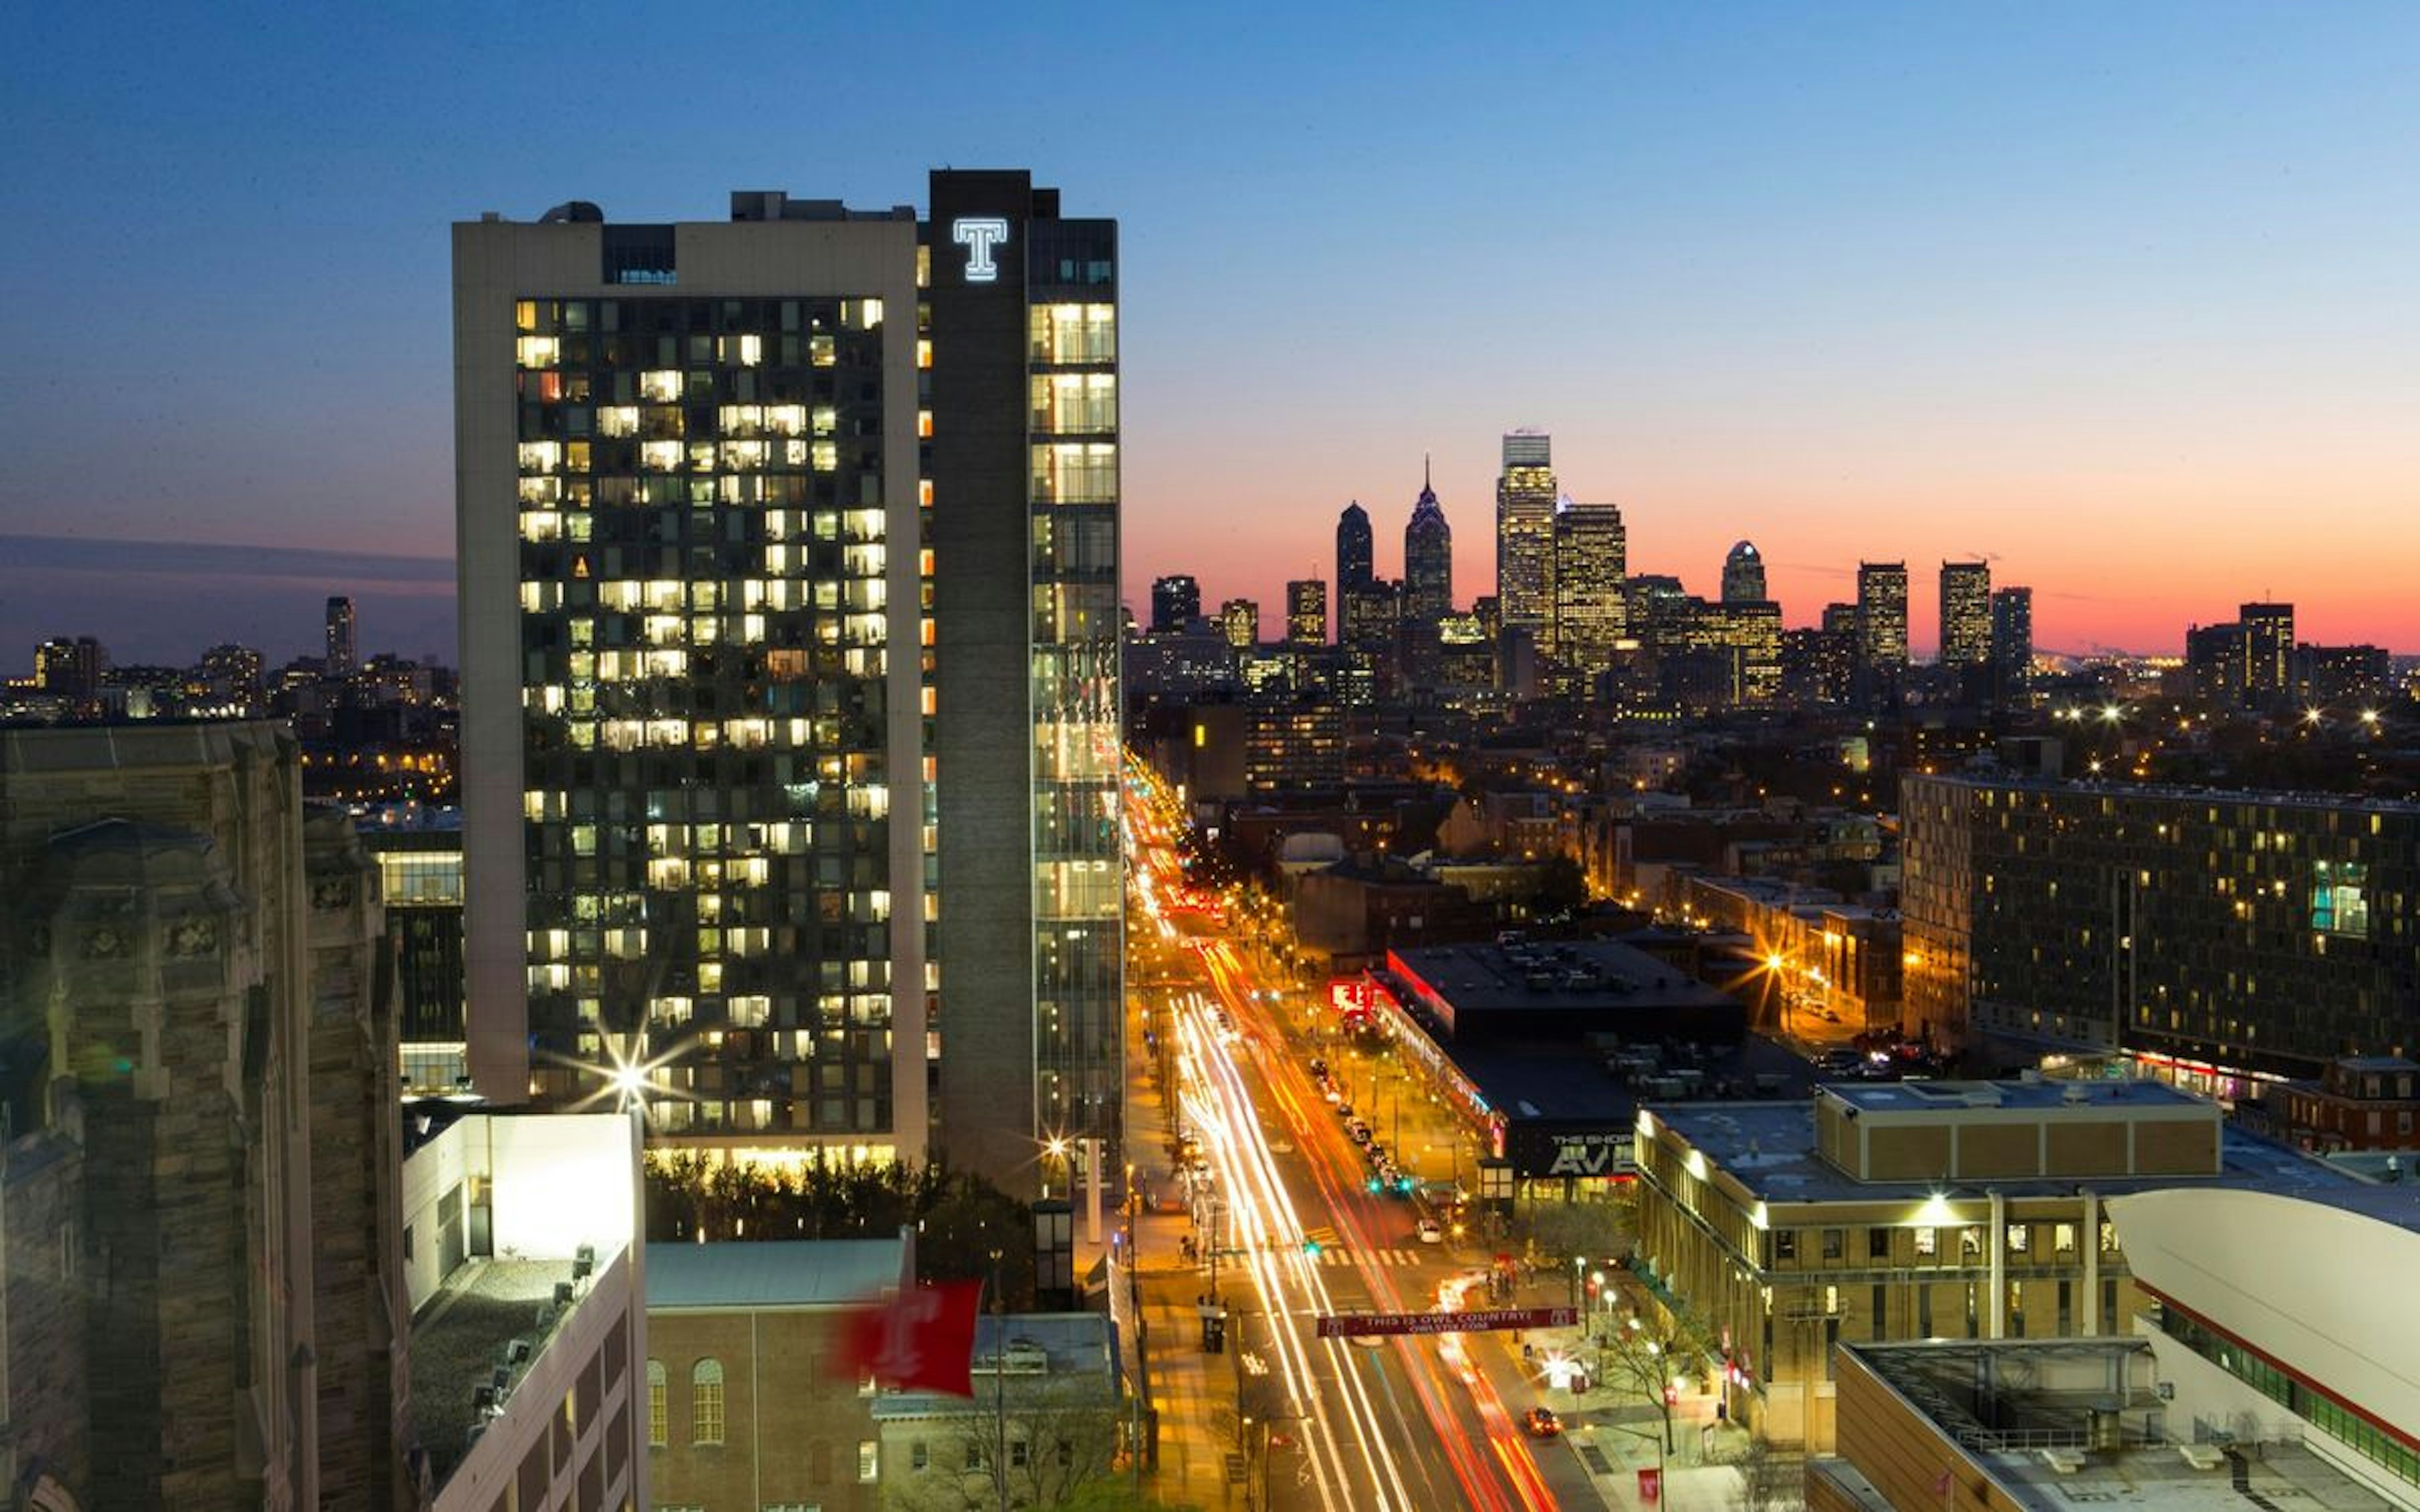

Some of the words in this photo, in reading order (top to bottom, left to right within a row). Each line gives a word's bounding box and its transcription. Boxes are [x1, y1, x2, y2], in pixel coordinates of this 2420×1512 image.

[954, 218, 1007, 281] T
[1551, 1136, 1584, 1145] THE
[1368, 1318, 1398, 1326] THIS
[1403, 1316, 1415, 1325] IS
[1421, 1315, 1452, 1324] OWL
